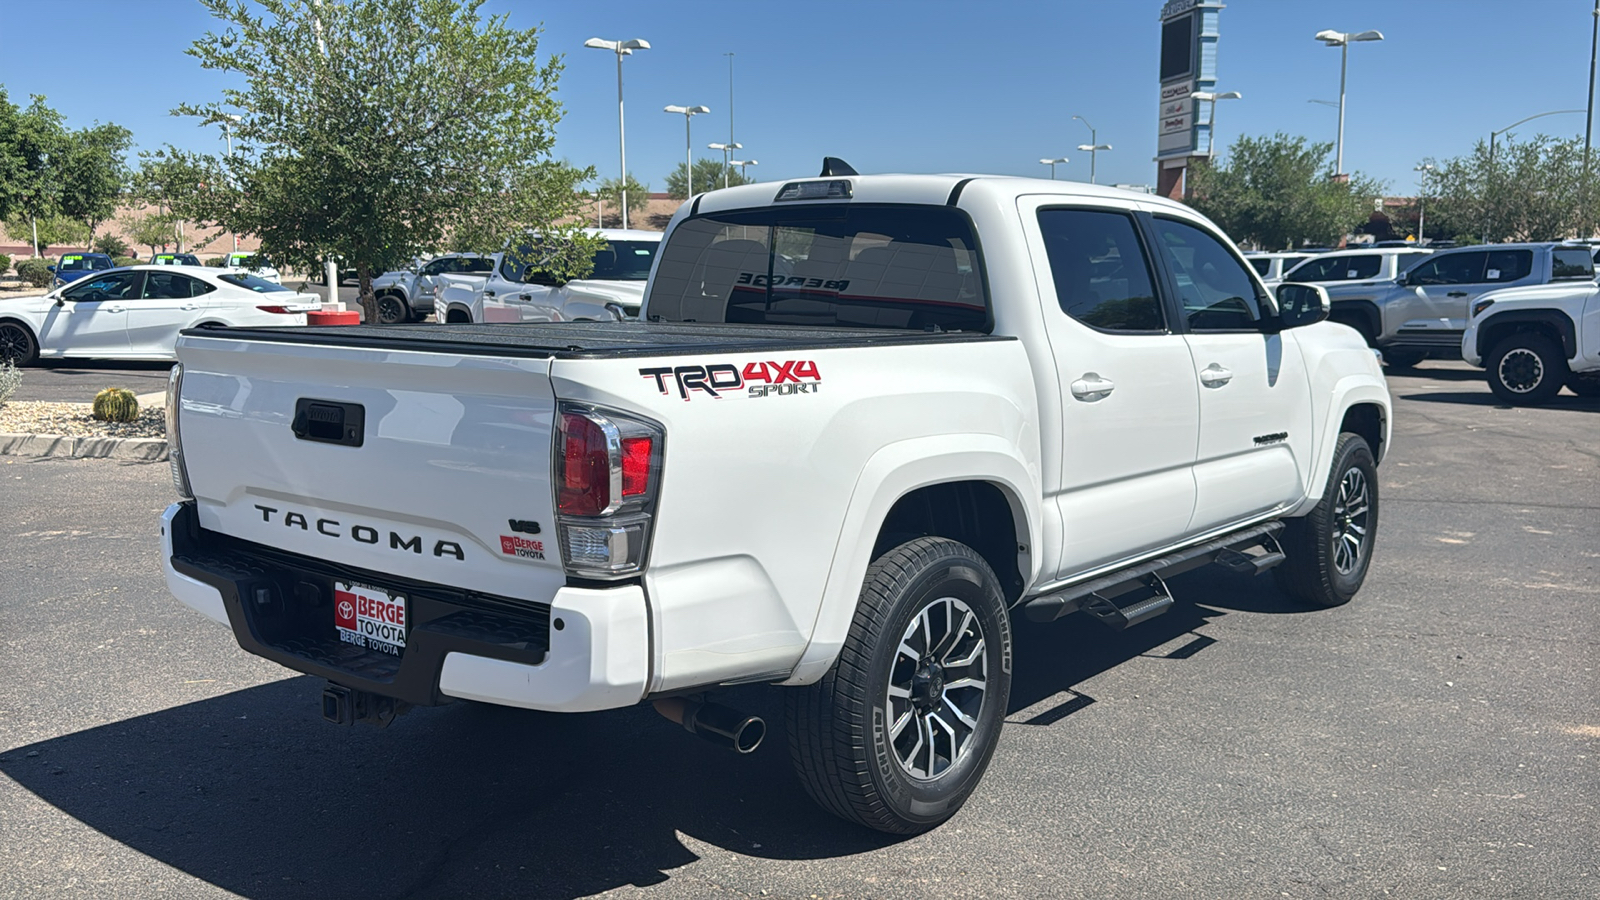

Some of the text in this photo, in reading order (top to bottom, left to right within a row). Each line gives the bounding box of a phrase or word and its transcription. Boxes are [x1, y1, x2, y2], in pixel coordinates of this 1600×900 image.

[638, 364, 744, 402] TRD
[748, 382, 821, 399] SPORT
[254, 504, 465, 561] TACOMA
[513, 536, 544, 551] BERGE
[515, 549, 546, 560] TOYOTA
[358, 595, 404, 625] BERGE
[341, 630, 399, 657] BERGE TOYOTA
[358, 619, 406, 643] TOYOTA
[991, 595, 1011, 670] MICHELIN
[874, 711, 900, 795] MICHELIN
